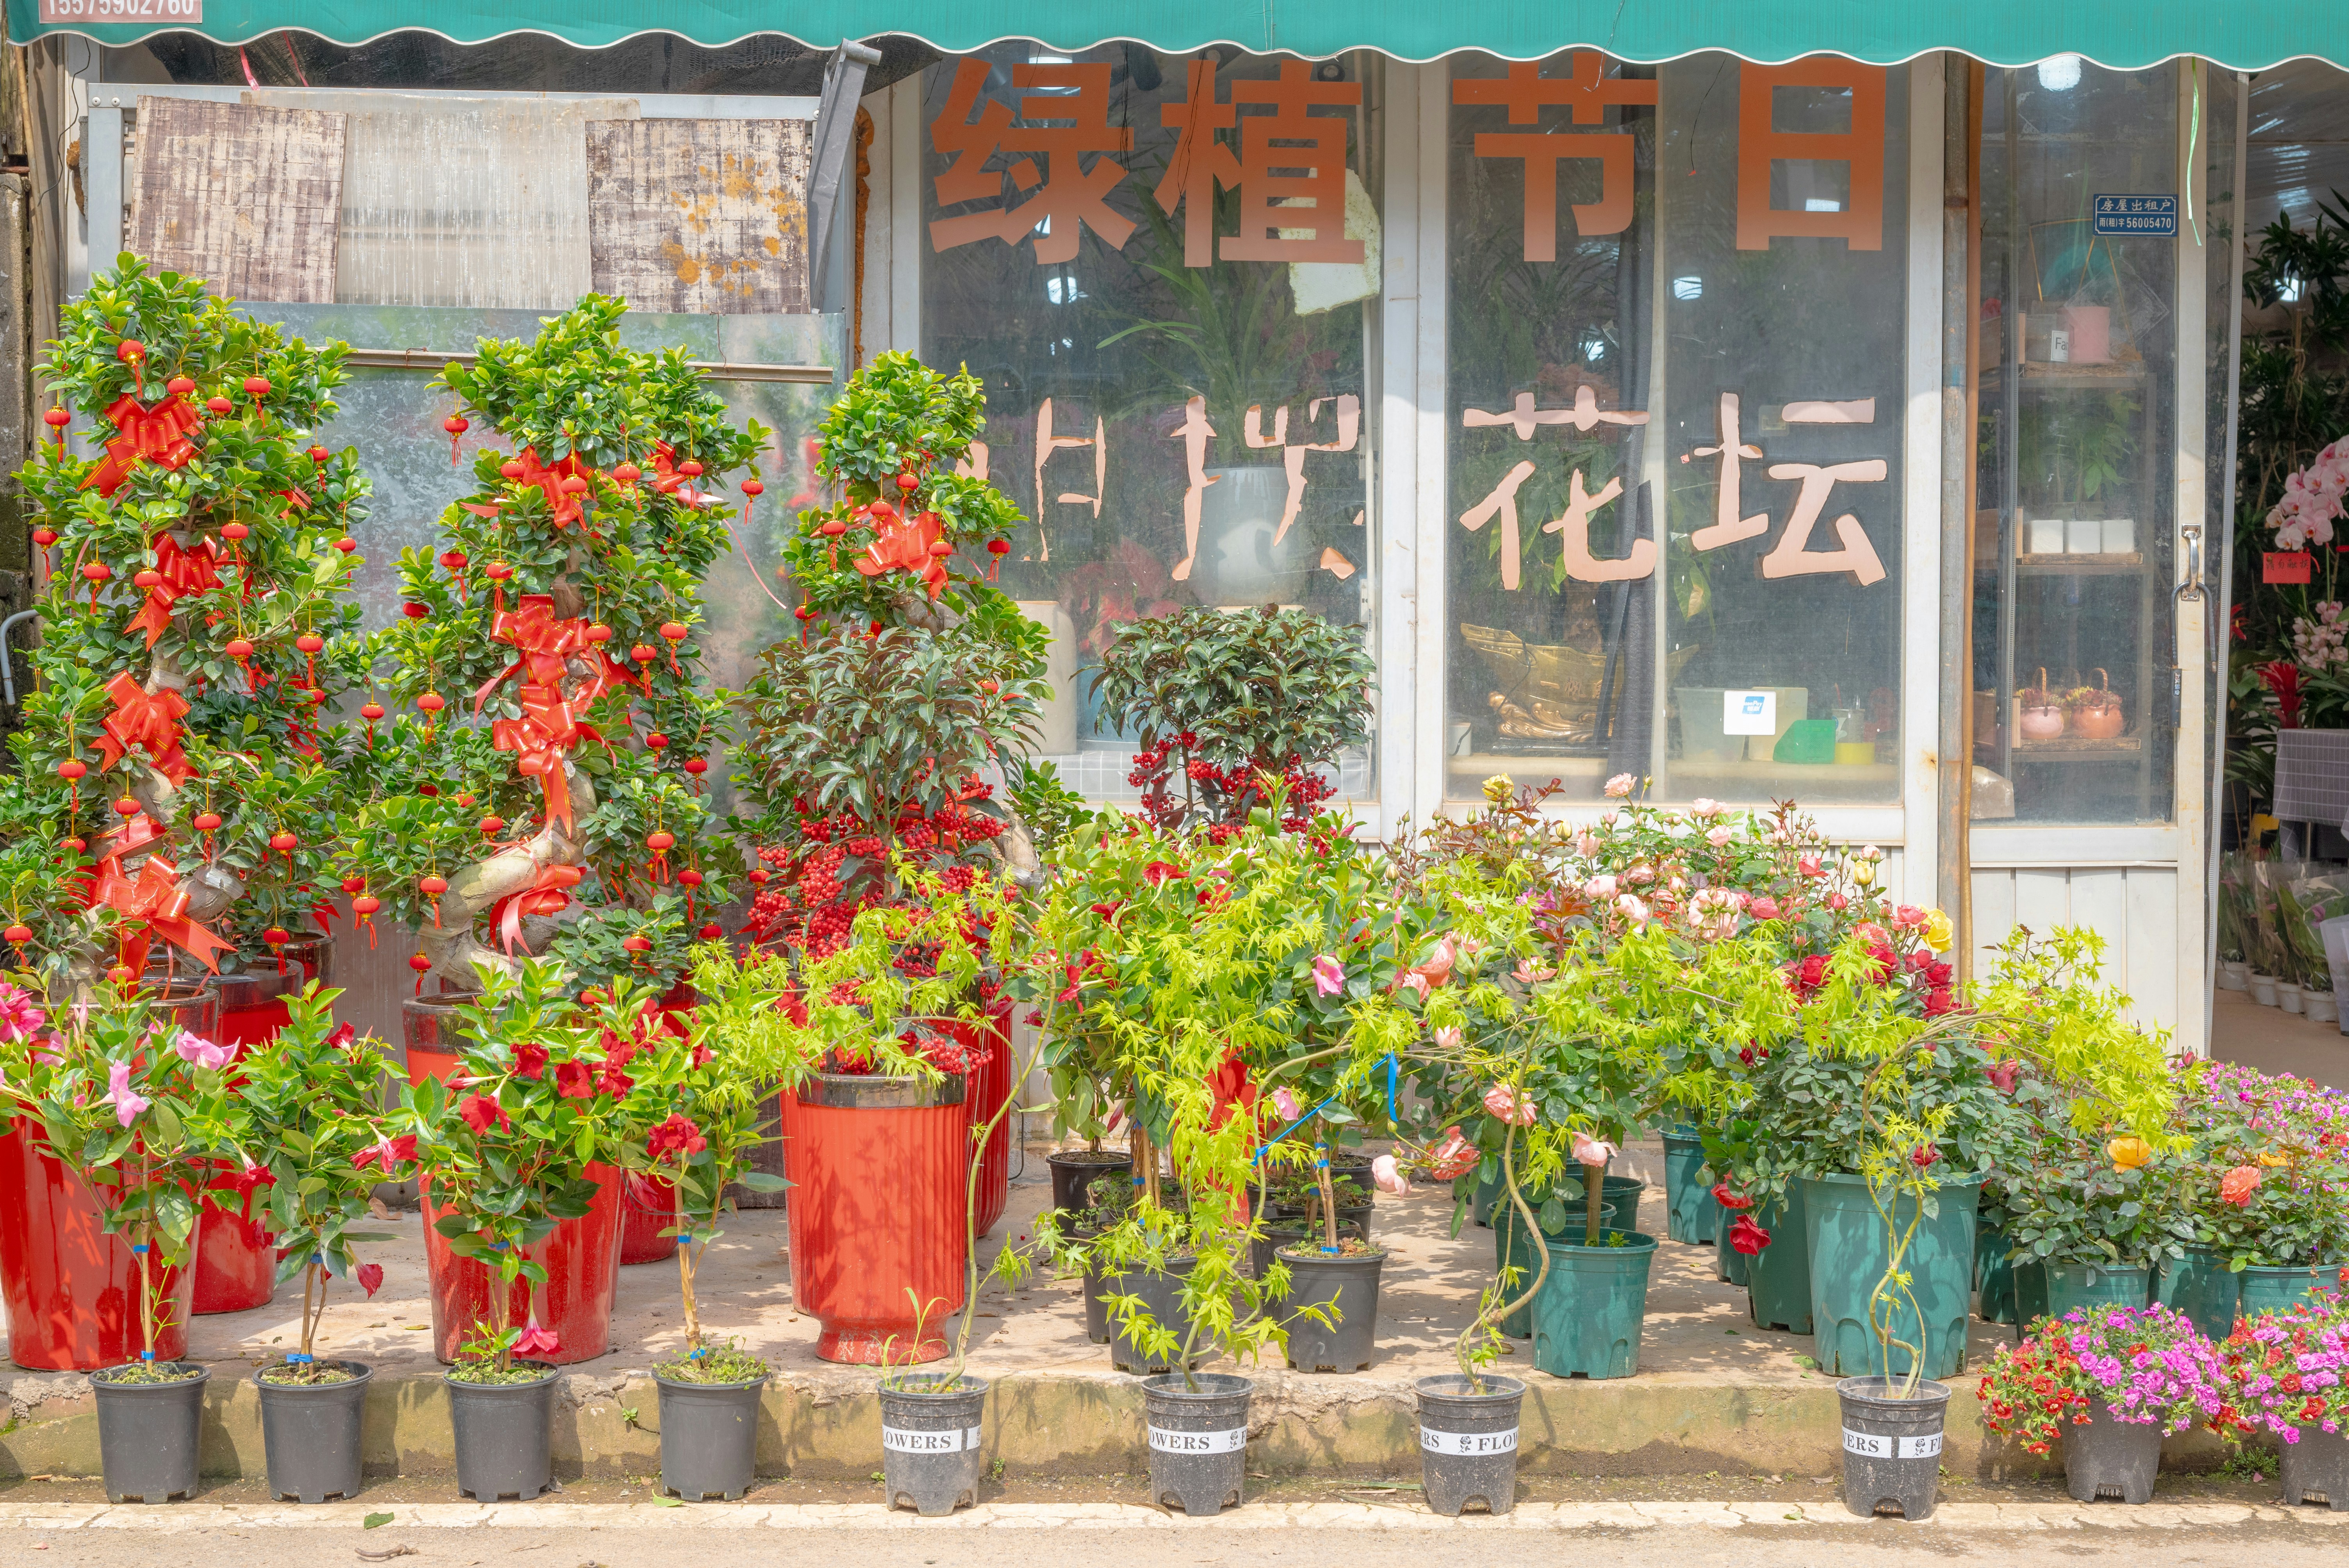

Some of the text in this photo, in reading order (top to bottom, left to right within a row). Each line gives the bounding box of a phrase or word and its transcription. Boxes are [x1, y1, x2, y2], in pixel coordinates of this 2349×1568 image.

[929, 52, 1887, 267] 绿植 节日
[2101, 198, 2171, 211] 房屋出租户
[2126, 217, 2172, 228] 56005470
[1459, 385, 1887, 590] 花坛
[1149, 1429, 1210, 1449] OWERS
